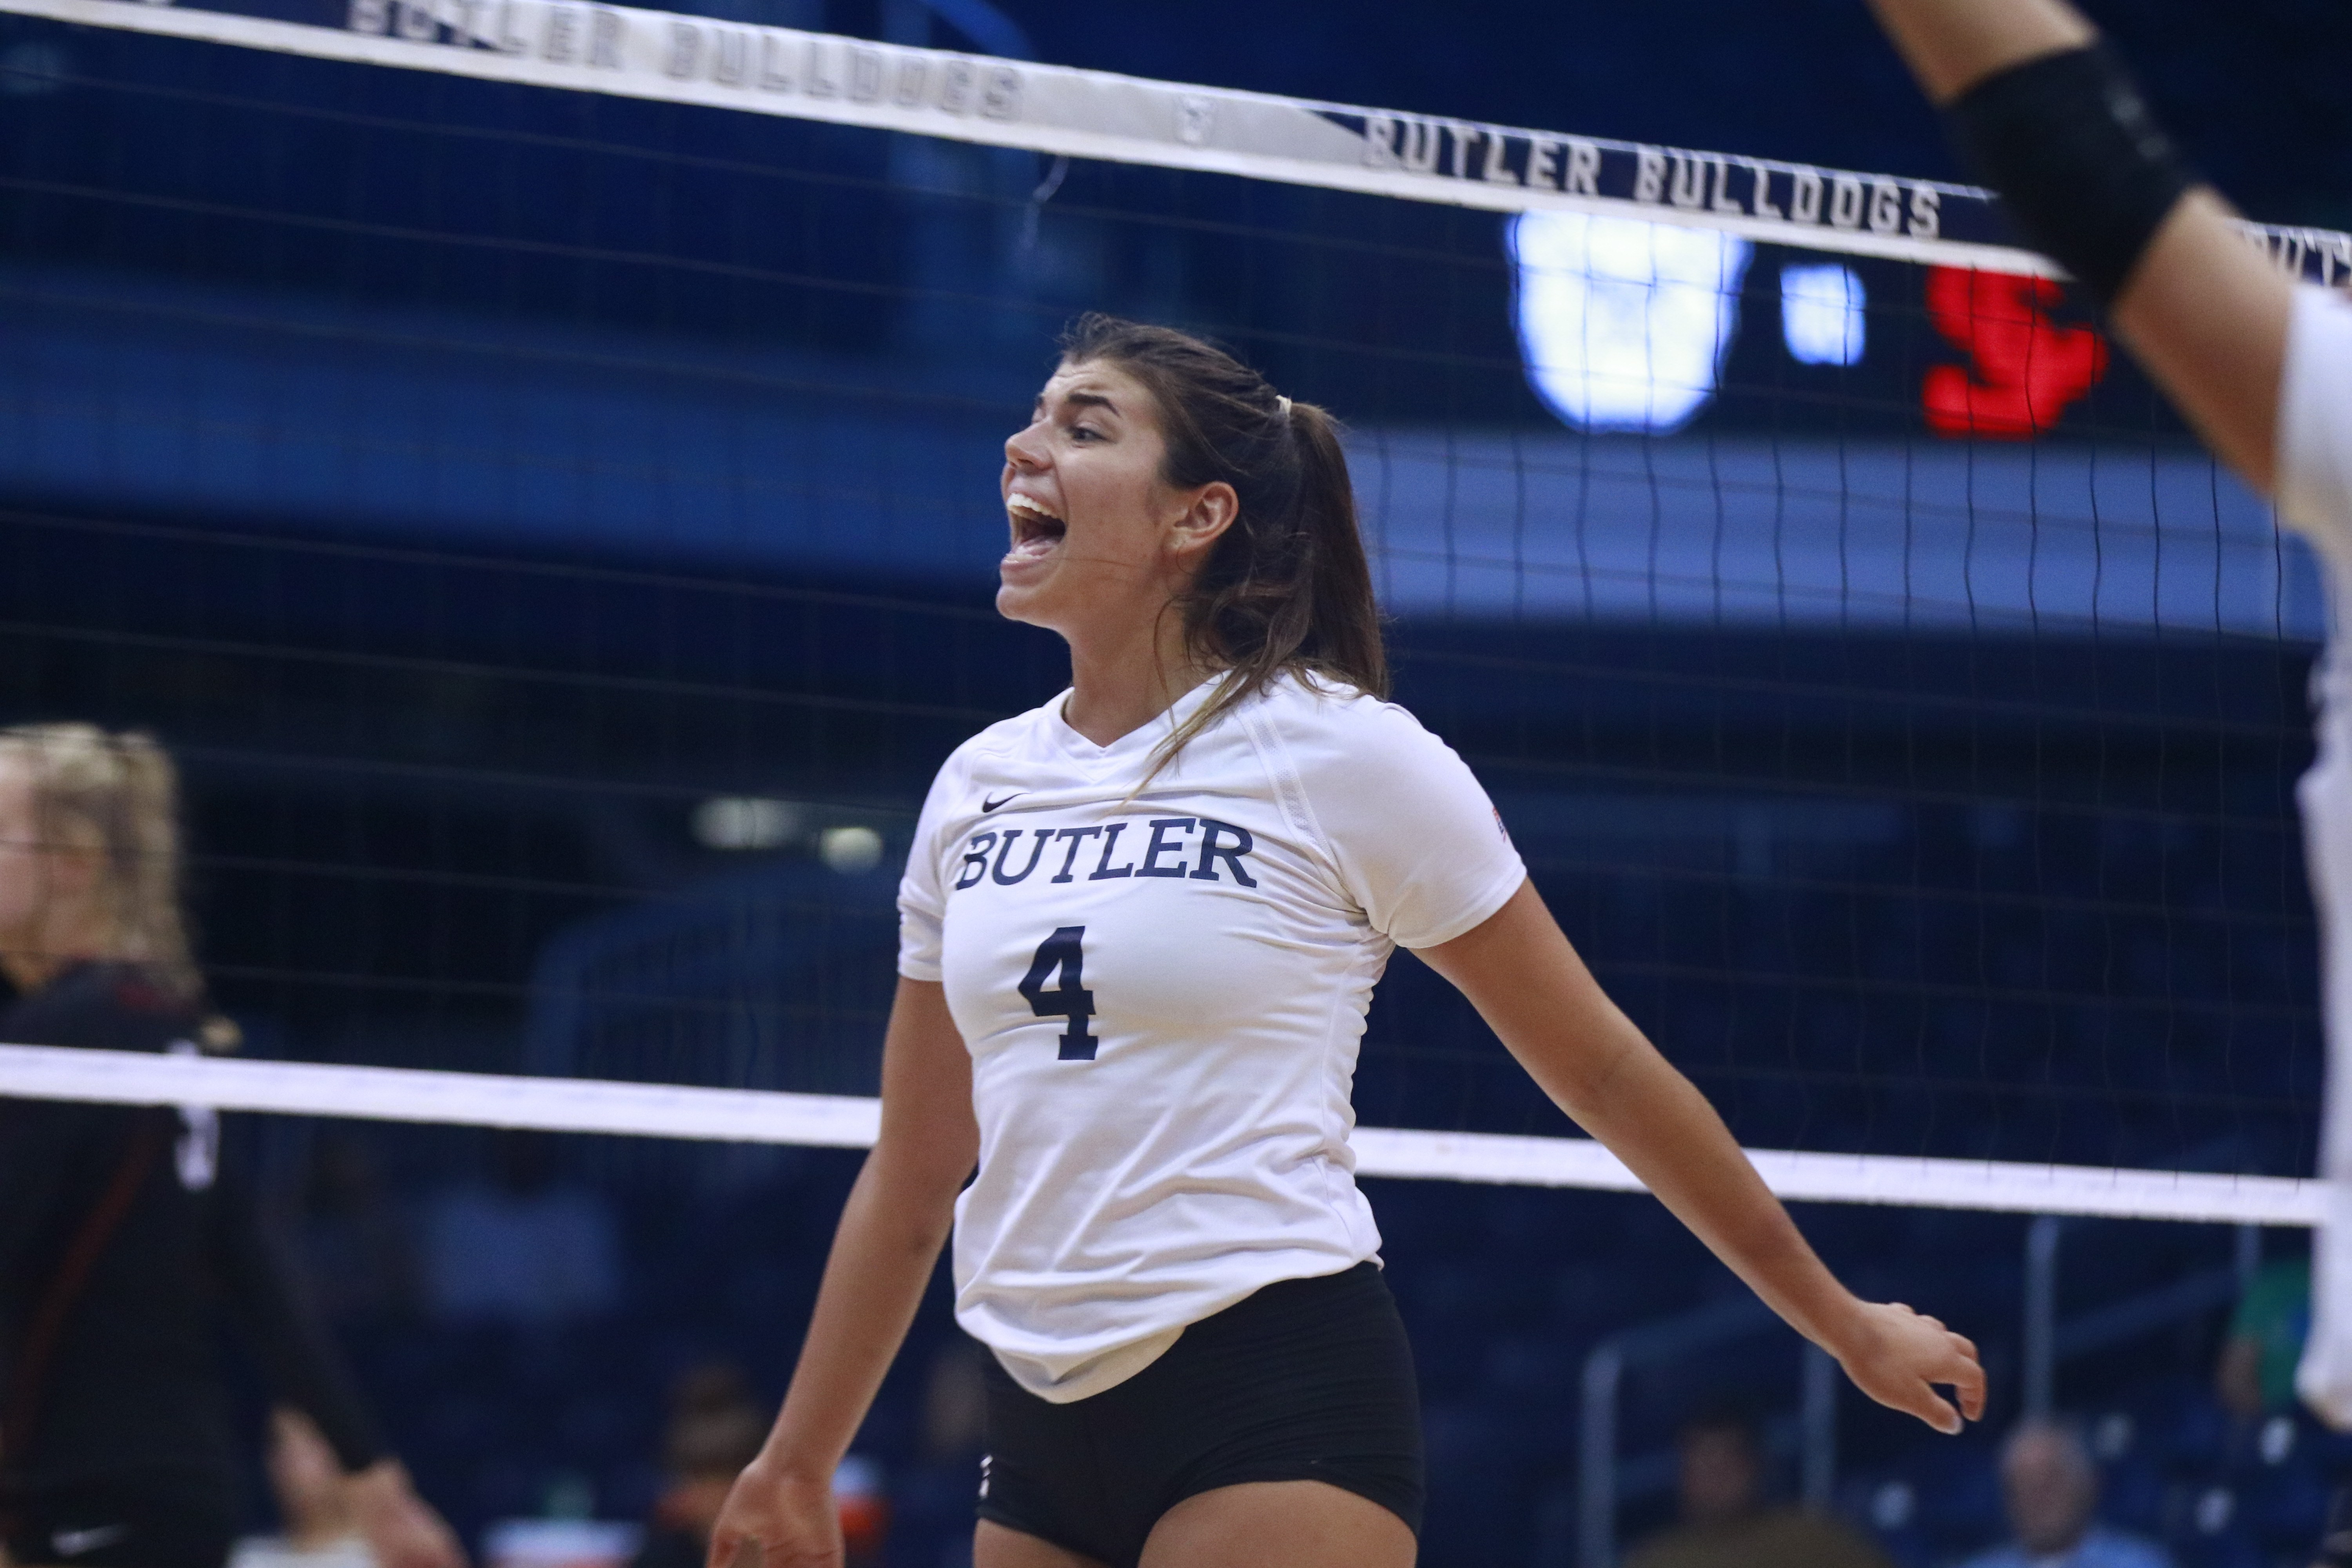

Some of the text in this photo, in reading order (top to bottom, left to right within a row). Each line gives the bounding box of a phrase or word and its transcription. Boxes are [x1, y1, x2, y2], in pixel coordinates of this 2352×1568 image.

[662, 21, 1022, 121] BULLDOGS
[1364, 114, 1941, 239] BUTLER BULLDOGS
[956, 818, 1257, 891] BUTLER
[1017, 926, 1098, 1060] 4
